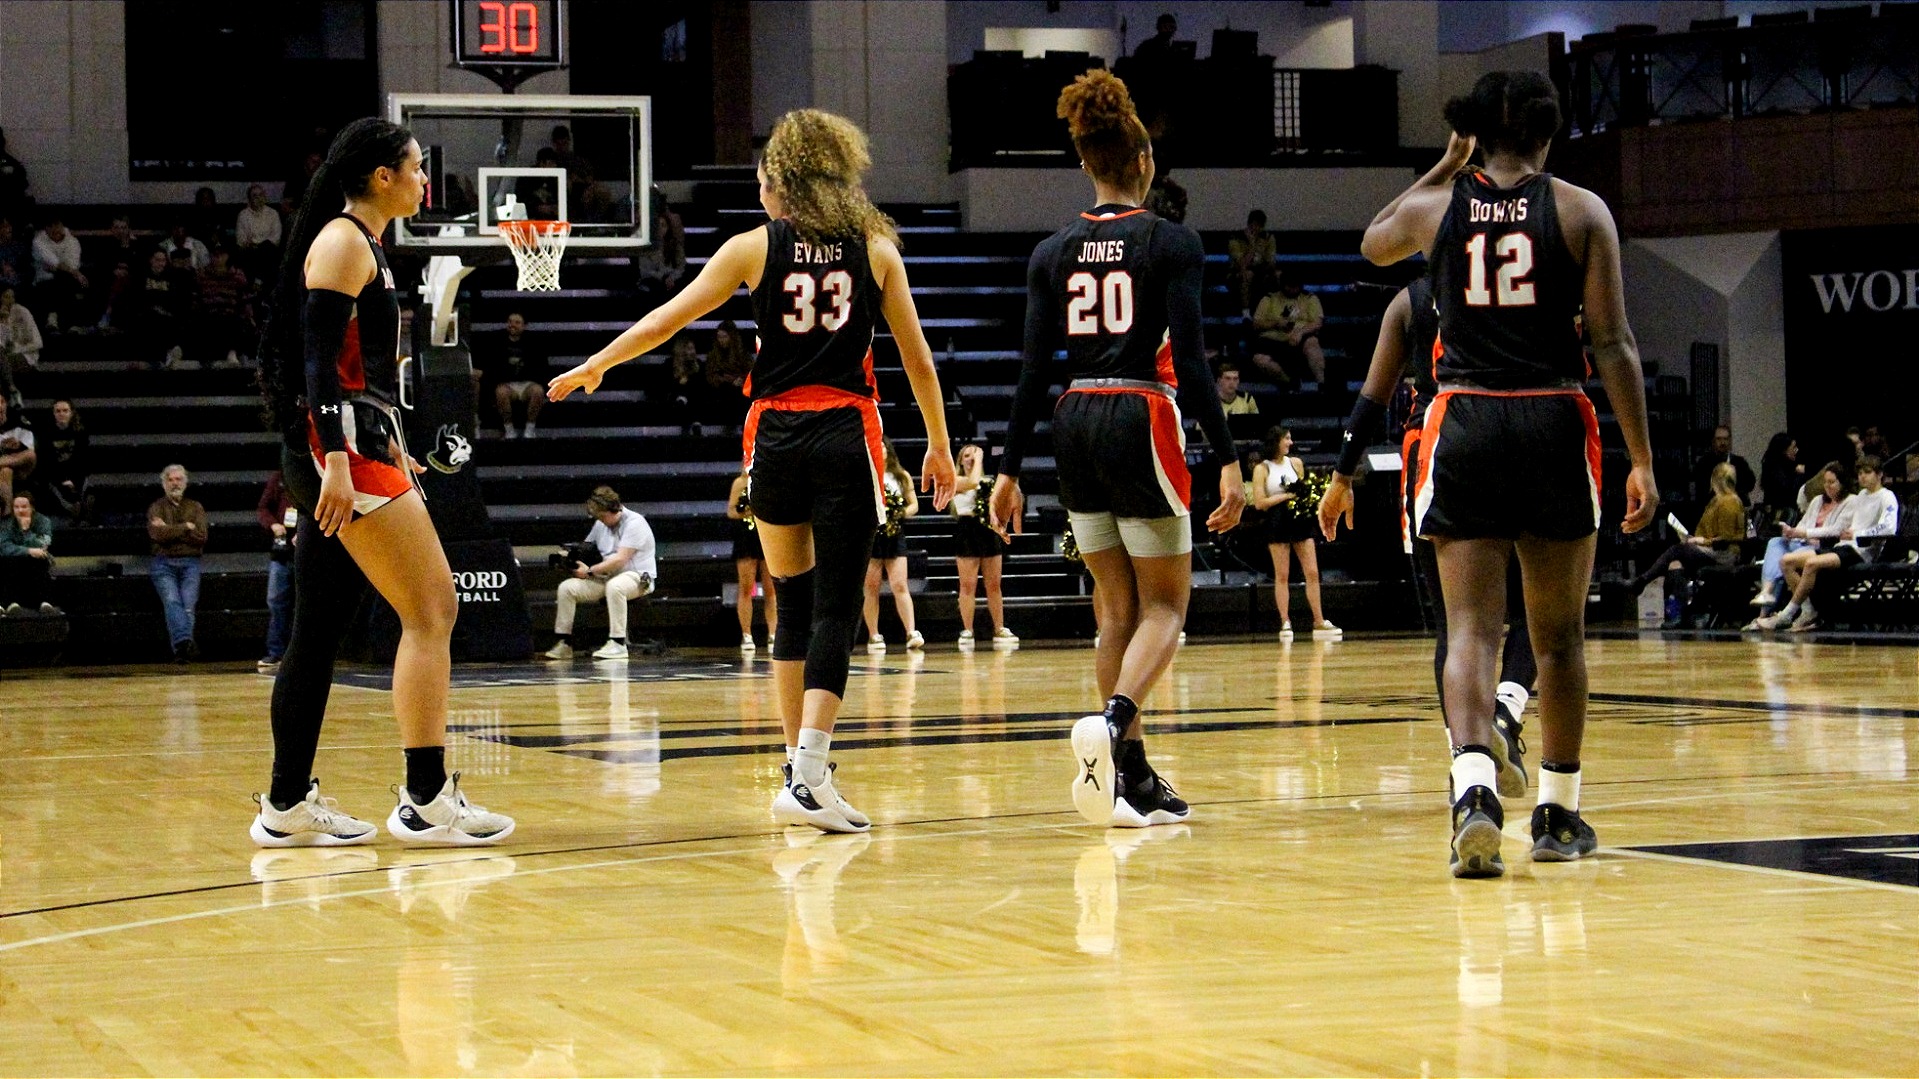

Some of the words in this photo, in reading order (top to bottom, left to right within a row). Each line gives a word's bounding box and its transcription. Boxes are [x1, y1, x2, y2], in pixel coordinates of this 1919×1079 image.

[480, 2, 537, 52] 30
[1470, 198, 1528, 222] DOWNS
[794, 242, 842, 263] EVANS
[1078, 240, 1124, 262] JONES
[1464, 232, 1535, 305] 12
[782, 271, 852, 333] 33
[1067, 270, 1133, 335] 20
